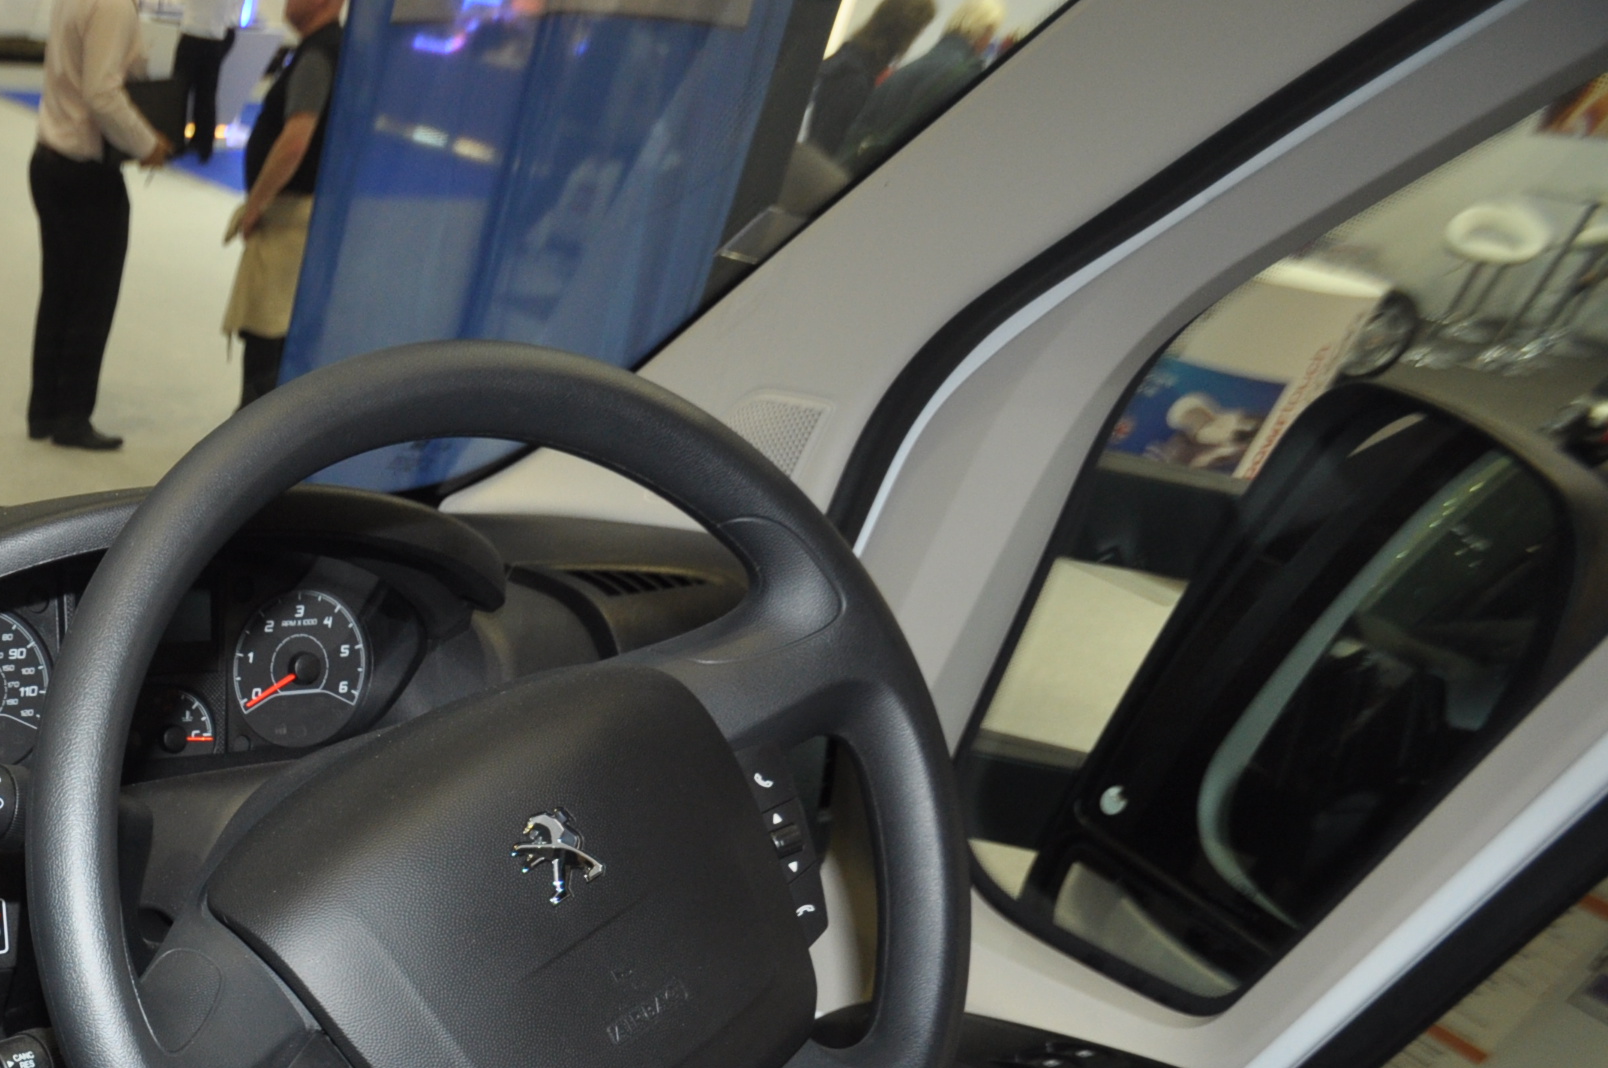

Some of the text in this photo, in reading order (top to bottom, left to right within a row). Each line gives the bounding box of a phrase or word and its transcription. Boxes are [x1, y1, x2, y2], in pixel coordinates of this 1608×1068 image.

[295, 605, 305, 617] 3
[264, 620, 274, 632] 2
[323, 616, 332, 628] 4
[1, 633, 13, 641] 80
[8, 648, 26, 659] 90
[340, 645, 350, 657] 5
[248, 652, 254, 663] 1
[19, 686, 38, 697] 110
[339, 681, 348, 693] 6
[12, 1051, 35, 1062] CANC
